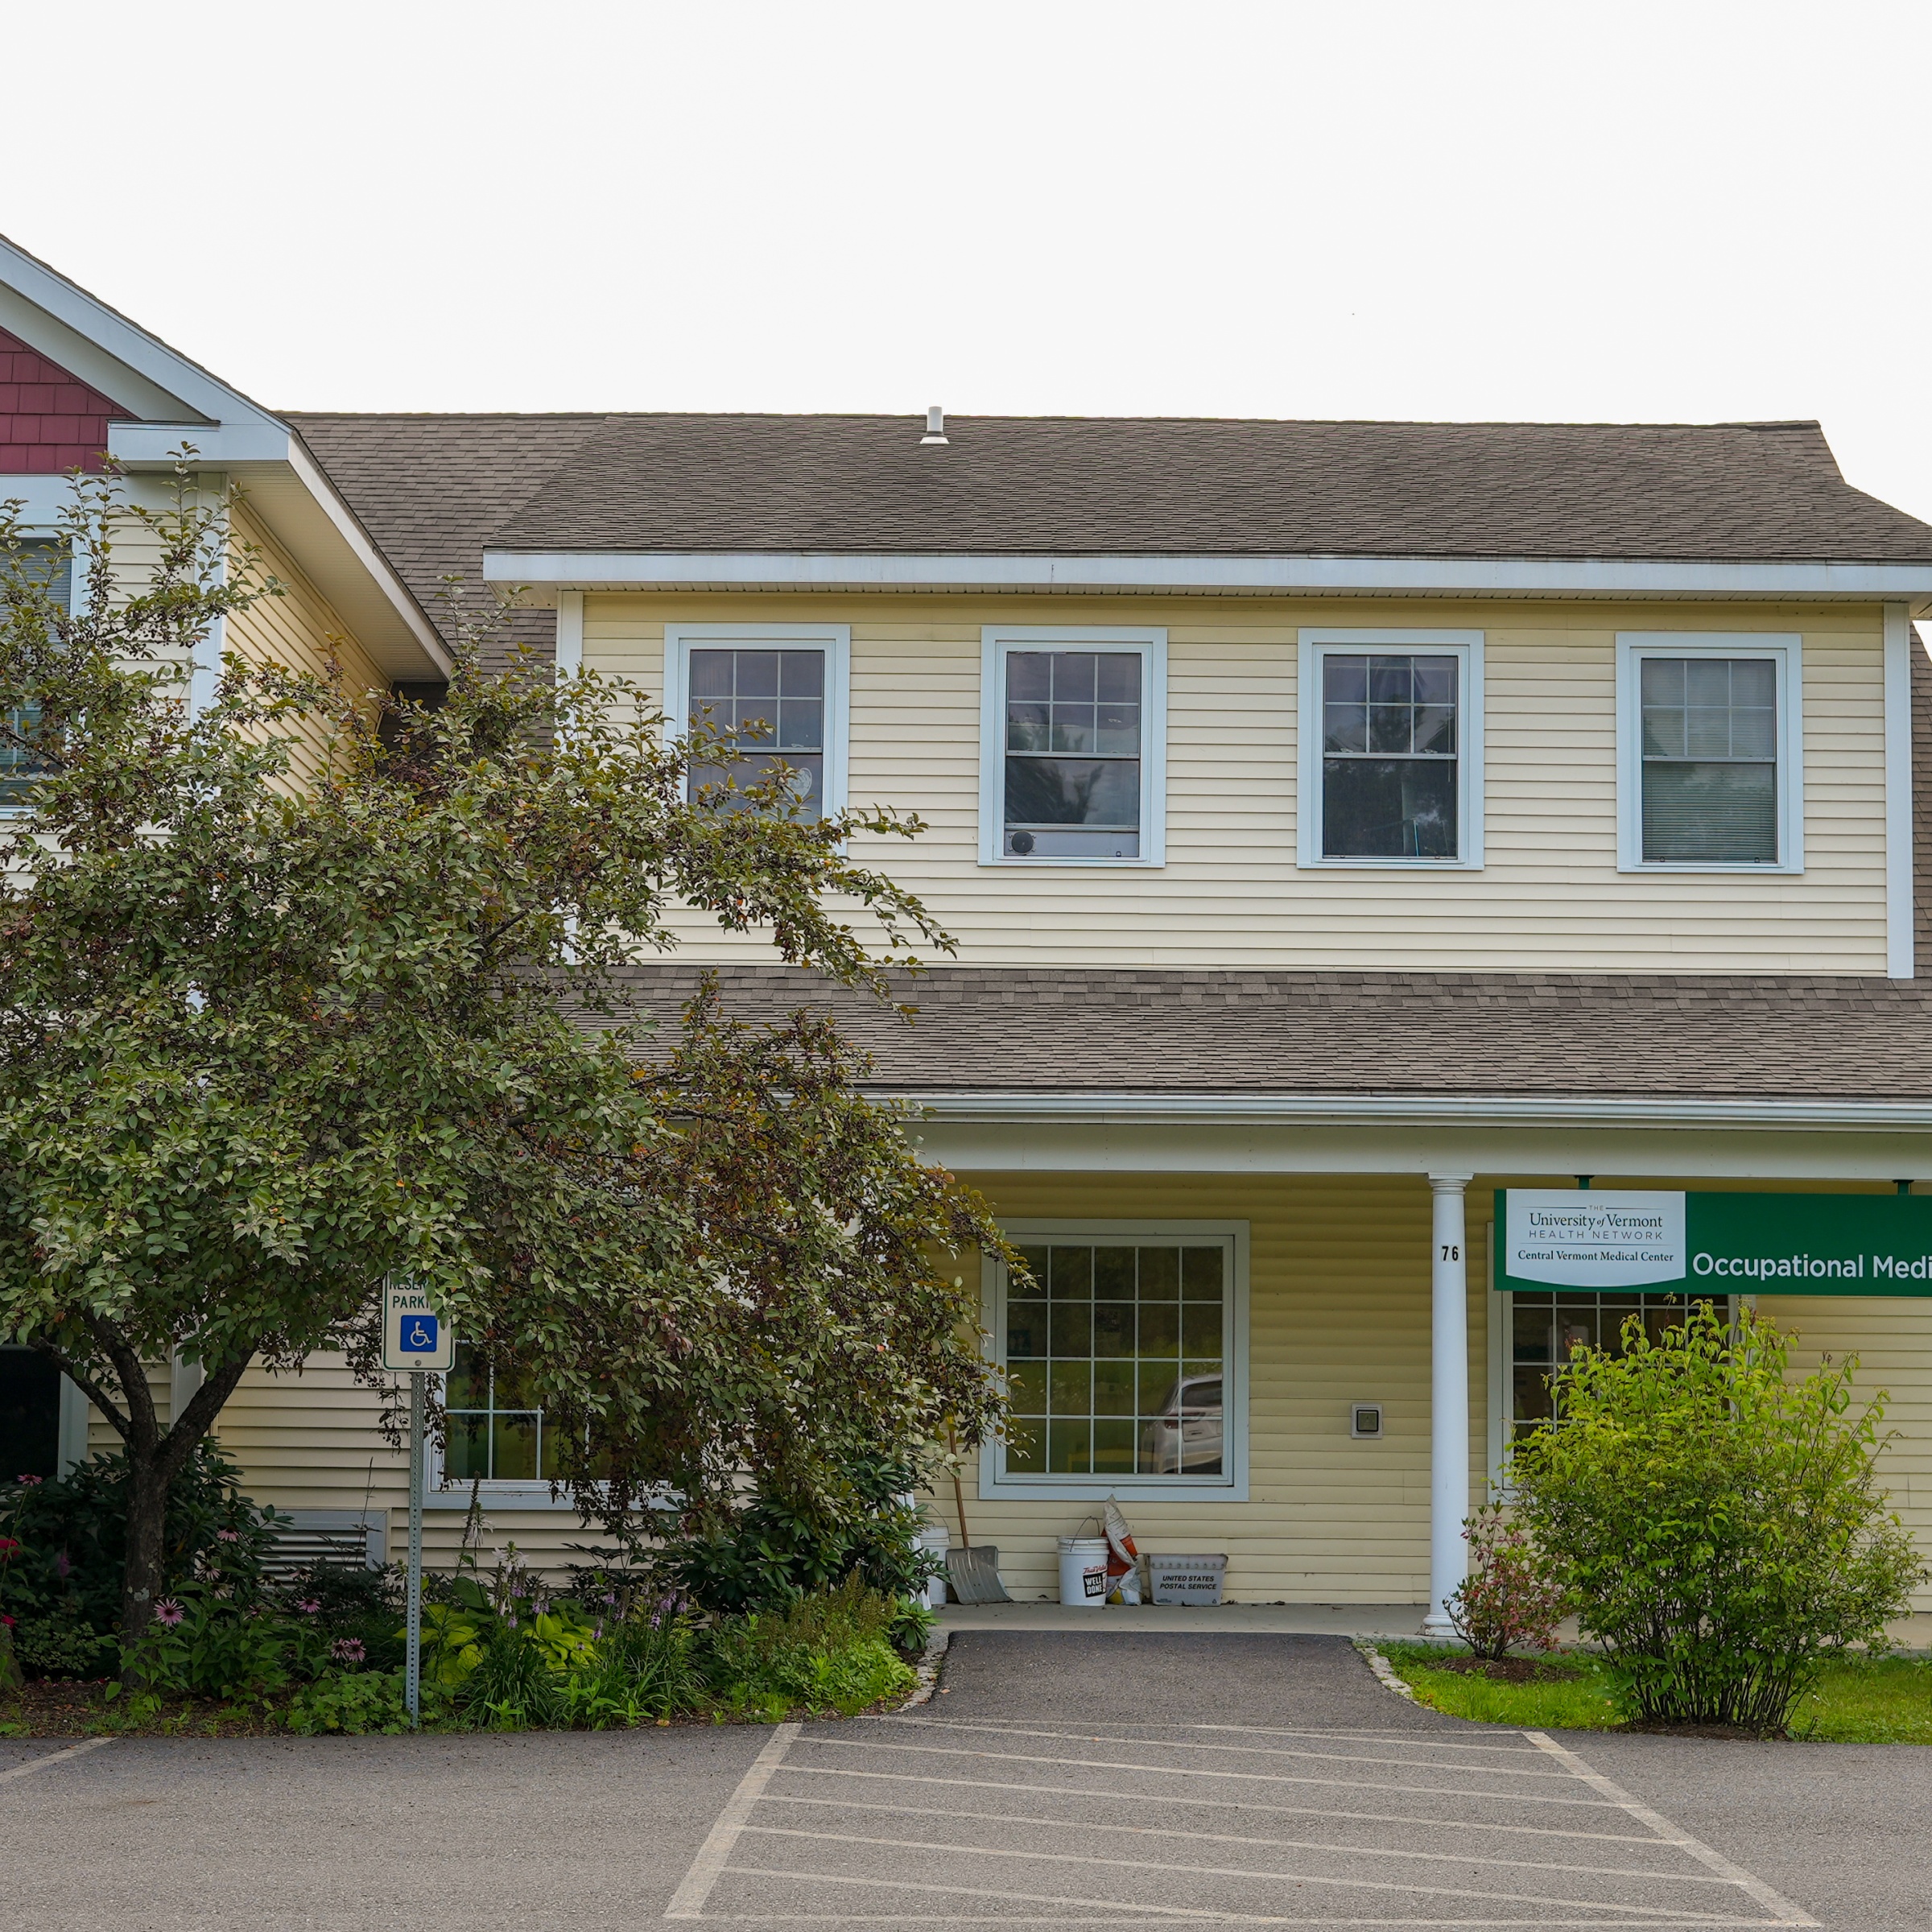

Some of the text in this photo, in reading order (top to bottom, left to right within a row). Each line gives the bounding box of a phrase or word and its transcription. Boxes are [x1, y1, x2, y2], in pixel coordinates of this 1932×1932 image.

[1530, 1212, 1662, 1231] University of Vermont
[1529, 1230, 1662, 1240] HEALTH NETWORK
[1442, 1245, 1459, 1261] 76
[1517, 1249, 1674, 1261] Central Vermont Medical Center
[1692, 1252, 1932, 1281] Occupational Medi
[393, 1295, 429, 1309] PARKI
[1084, 1575, 1102, 1586] WELL
